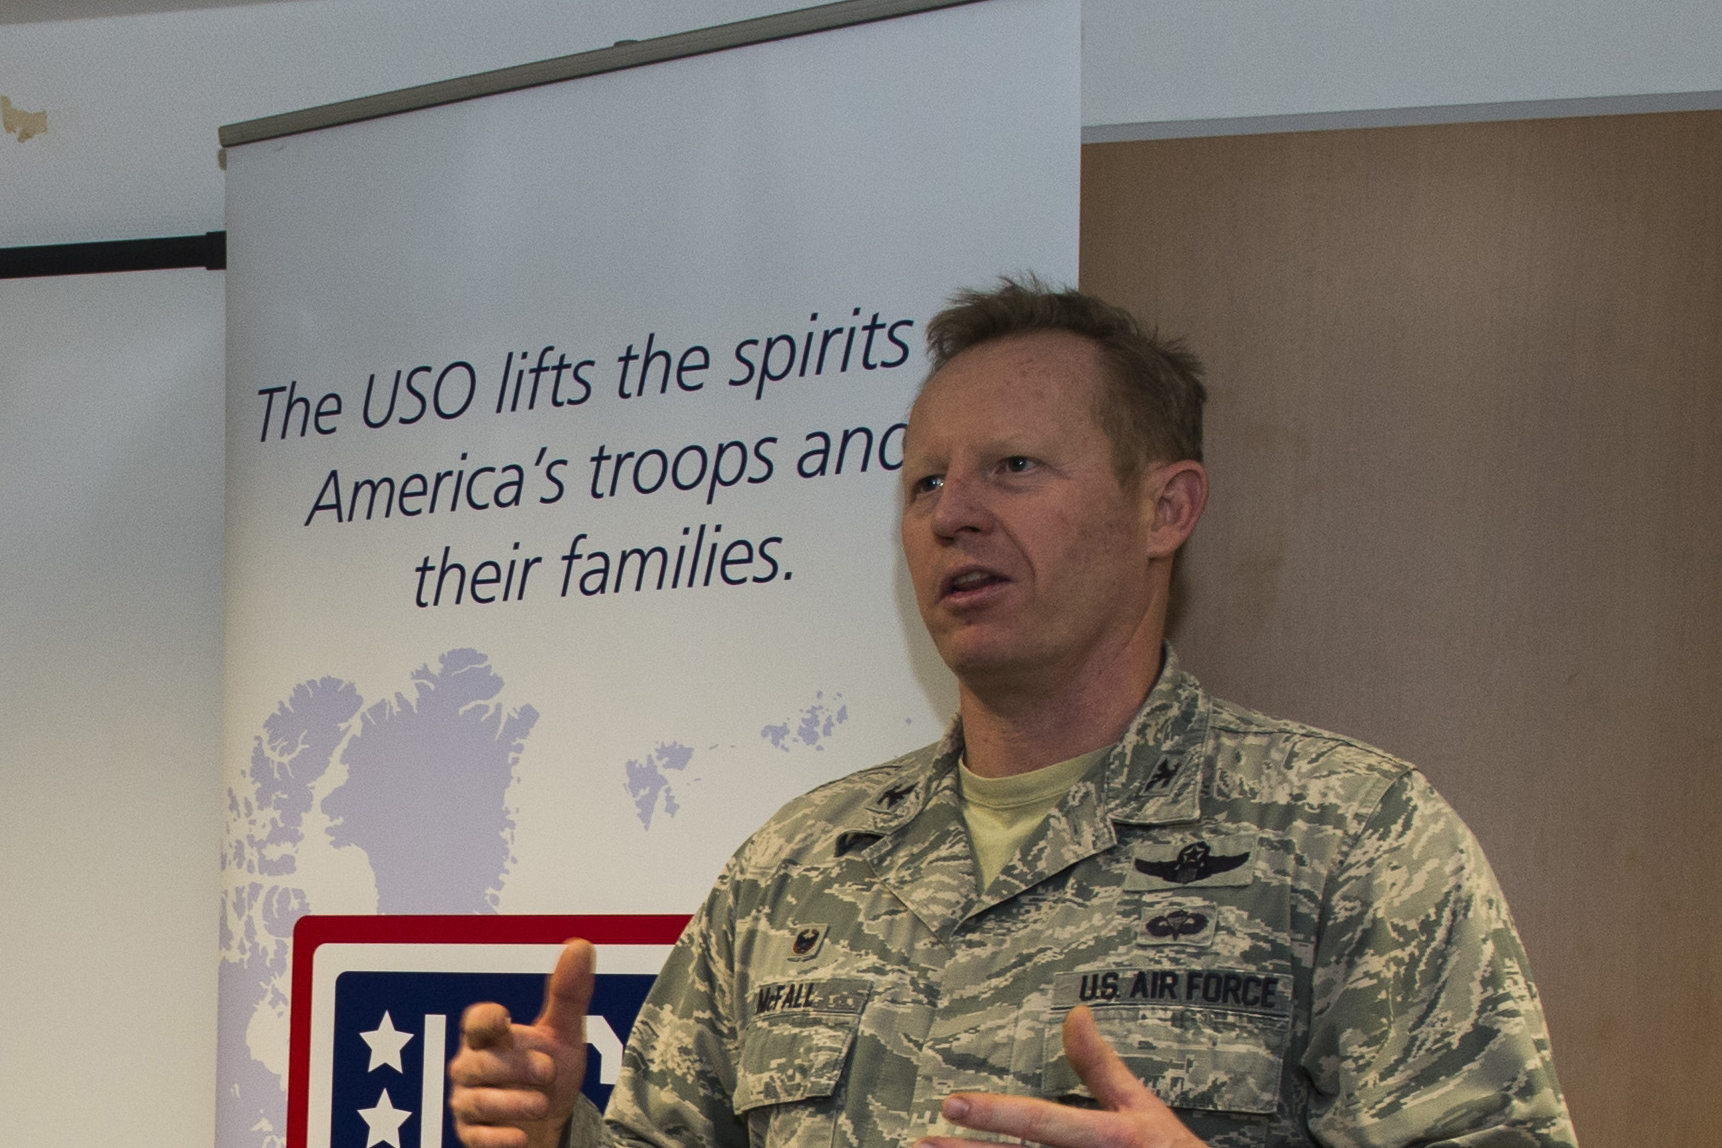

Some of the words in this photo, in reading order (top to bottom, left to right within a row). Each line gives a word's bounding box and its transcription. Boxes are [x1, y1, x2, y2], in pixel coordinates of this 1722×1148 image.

[256, 380, 342, 442] The
[361, 361, 477, 429] USO
[495, 345, 595, 414] lifts
[617, 333, 710, 399] the
[728, 307, 914, 400] spirits
[304, 447, 567, 526] America's
[589, 432, 777, 504] troops
[413, 542, 542, 608] their
[559, 523, 794, 598] families.
[1079, 972, 1120, 1000] U.S.
[1130, 970, 1178, 999] AIR
[1186, 971, 1279, 1008] FORCE
